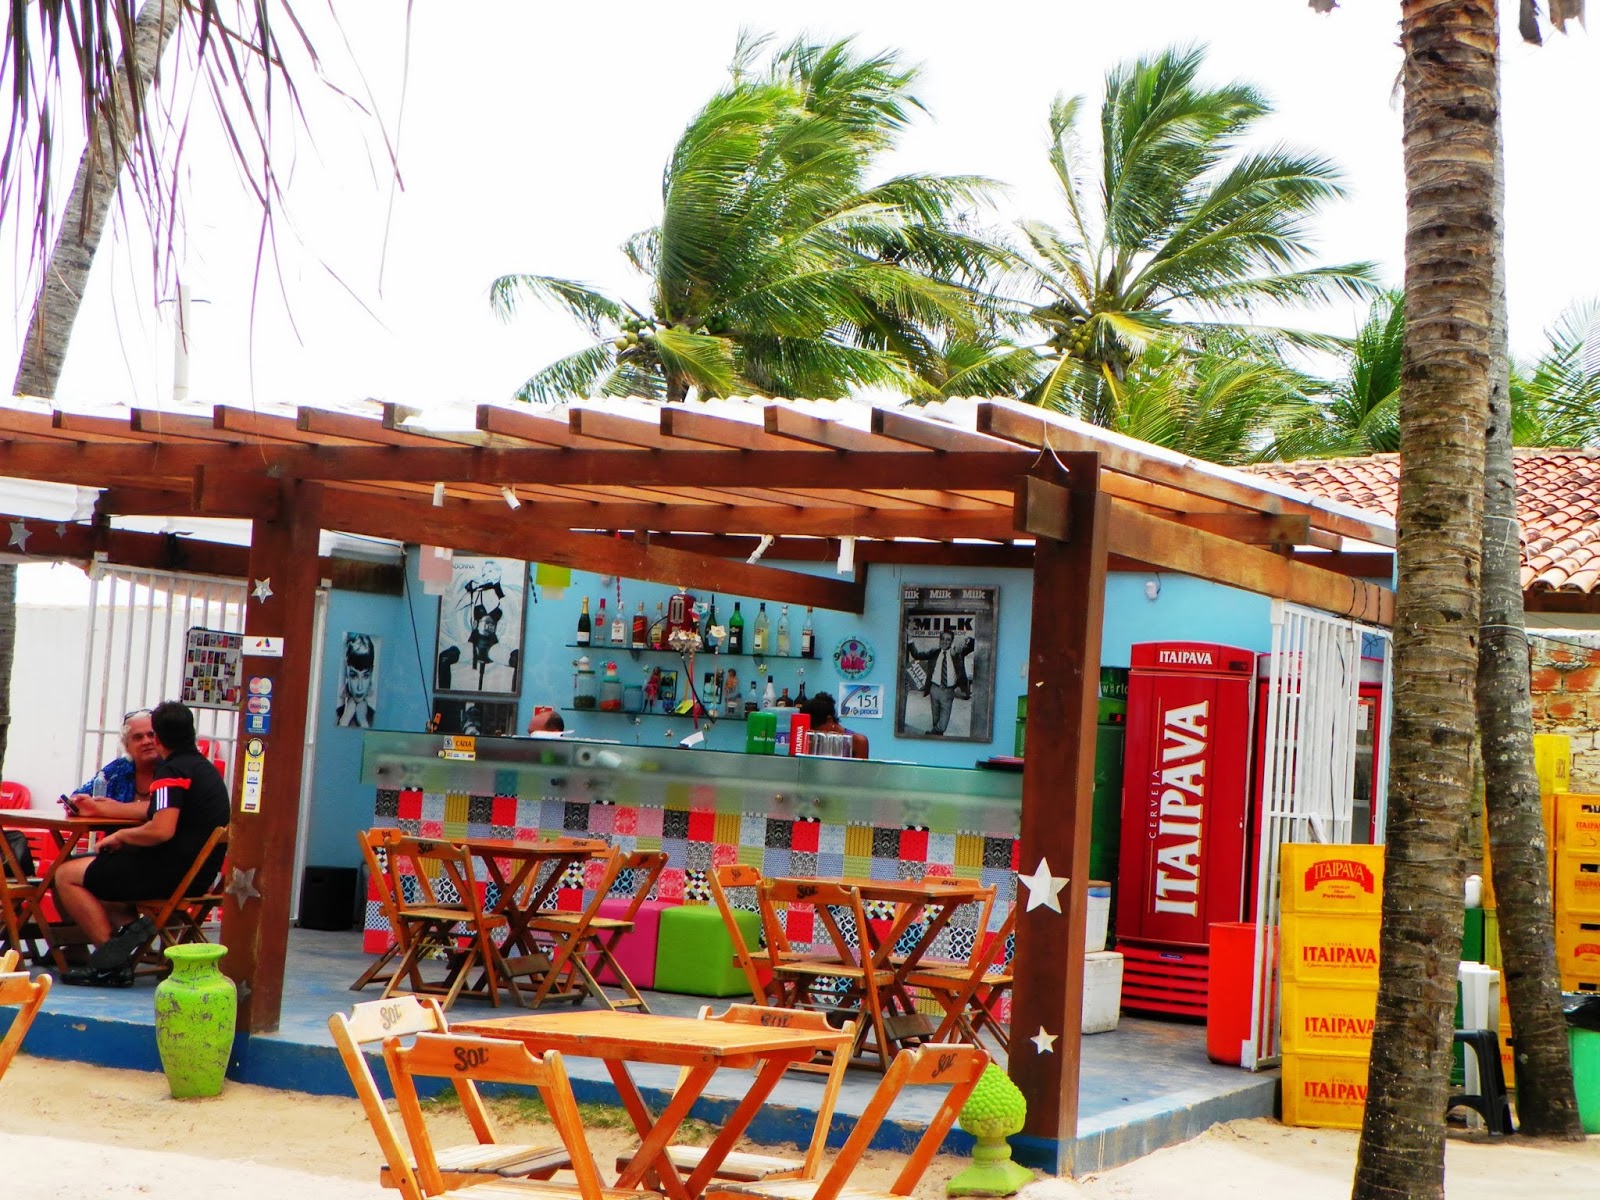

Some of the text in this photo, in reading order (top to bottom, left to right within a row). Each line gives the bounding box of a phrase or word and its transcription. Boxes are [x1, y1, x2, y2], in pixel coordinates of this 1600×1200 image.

[929, 589, 952, 599] Milk
[961, 589, 986, 599] Milk
[913, 617, 973, 631] MILK
[1159, 650, 1213, 665] ITAIPAVA
[857, 694, 879, 708] 151
[1149, 769, 1161, 839] CERVEJA
[1154, 699, 1210, 919] ITAIPAVA
[1314, 862, 1365, 881] ITAIPAVA
[1303, 946, 1378, 964] ITAIPAVA
[380, 1004, 402, 1030] SOL
[1304, 1016, 1375, 1034] ITAIPAVA
[453, 1046, 489, 1071] SOL
[931, 1052, 958, 1078] SOL
[1304, 1081, 1368, 1101] ITAIPAV
